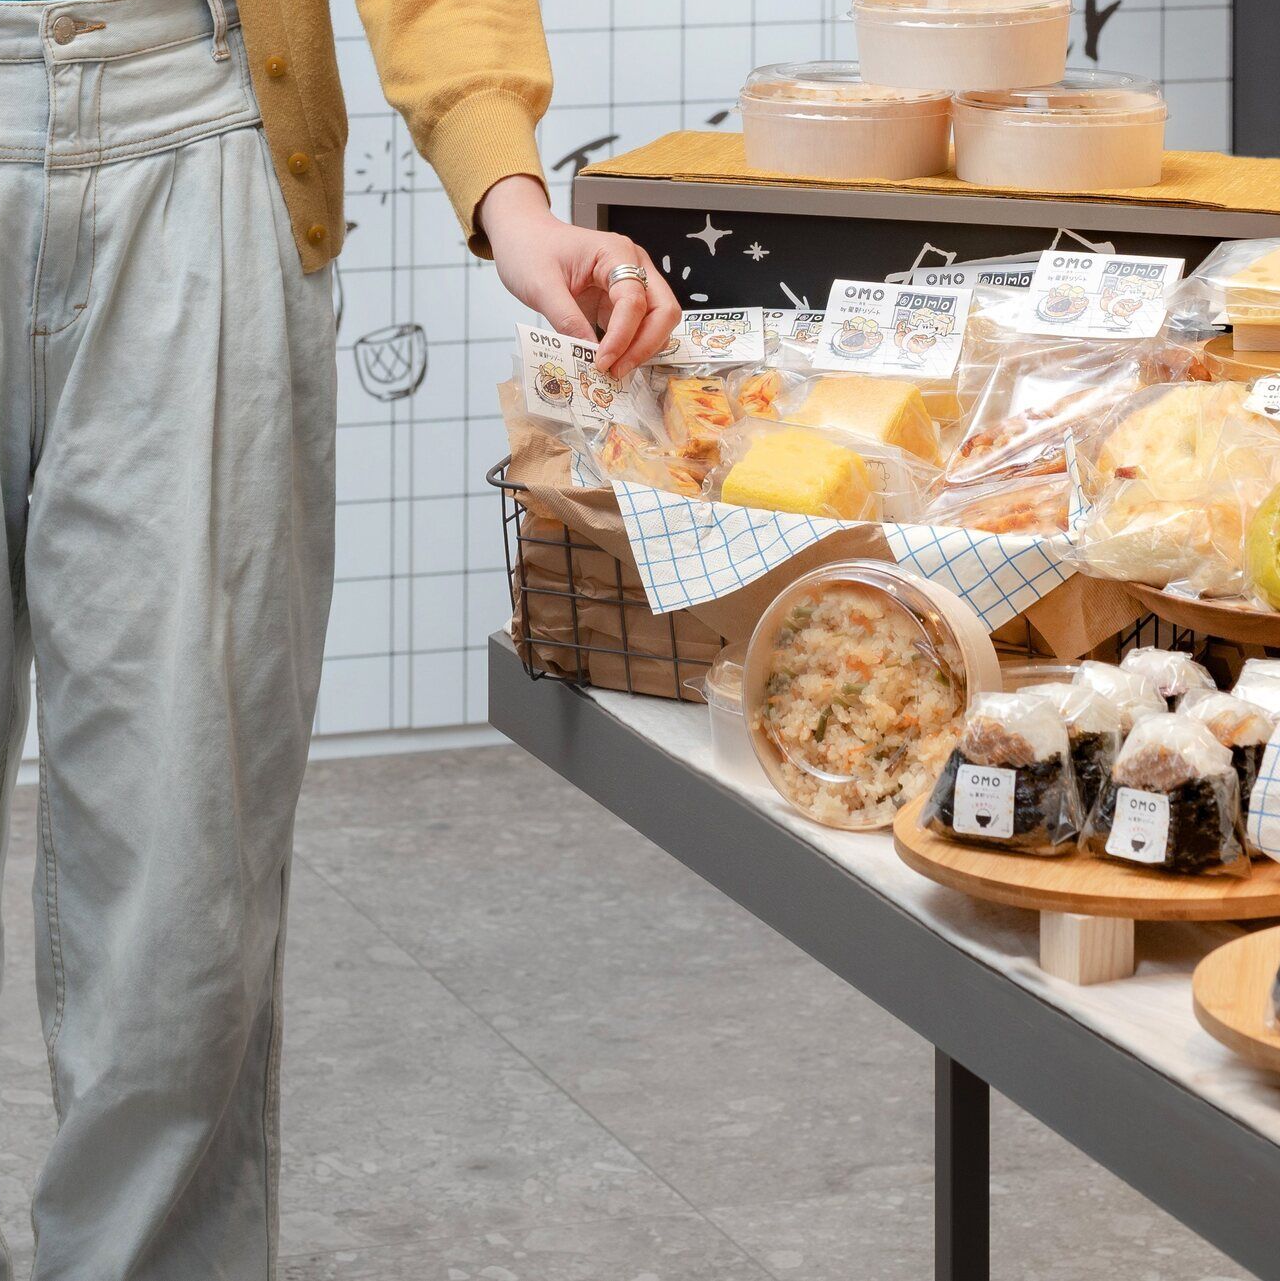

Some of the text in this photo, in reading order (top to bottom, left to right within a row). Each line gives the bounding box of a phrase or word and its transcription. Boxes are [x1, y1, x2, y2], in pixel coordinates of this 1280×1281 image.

[1053, 257, 1093, 269] OMO
[926, 272, 965, 285] OMO
[845, 286, 885, 301] OMO
[530, 331, 561, 349] OMO
[971, 775, 1000, 787] OMO
[1130, 799, 1156, 812] OMO
